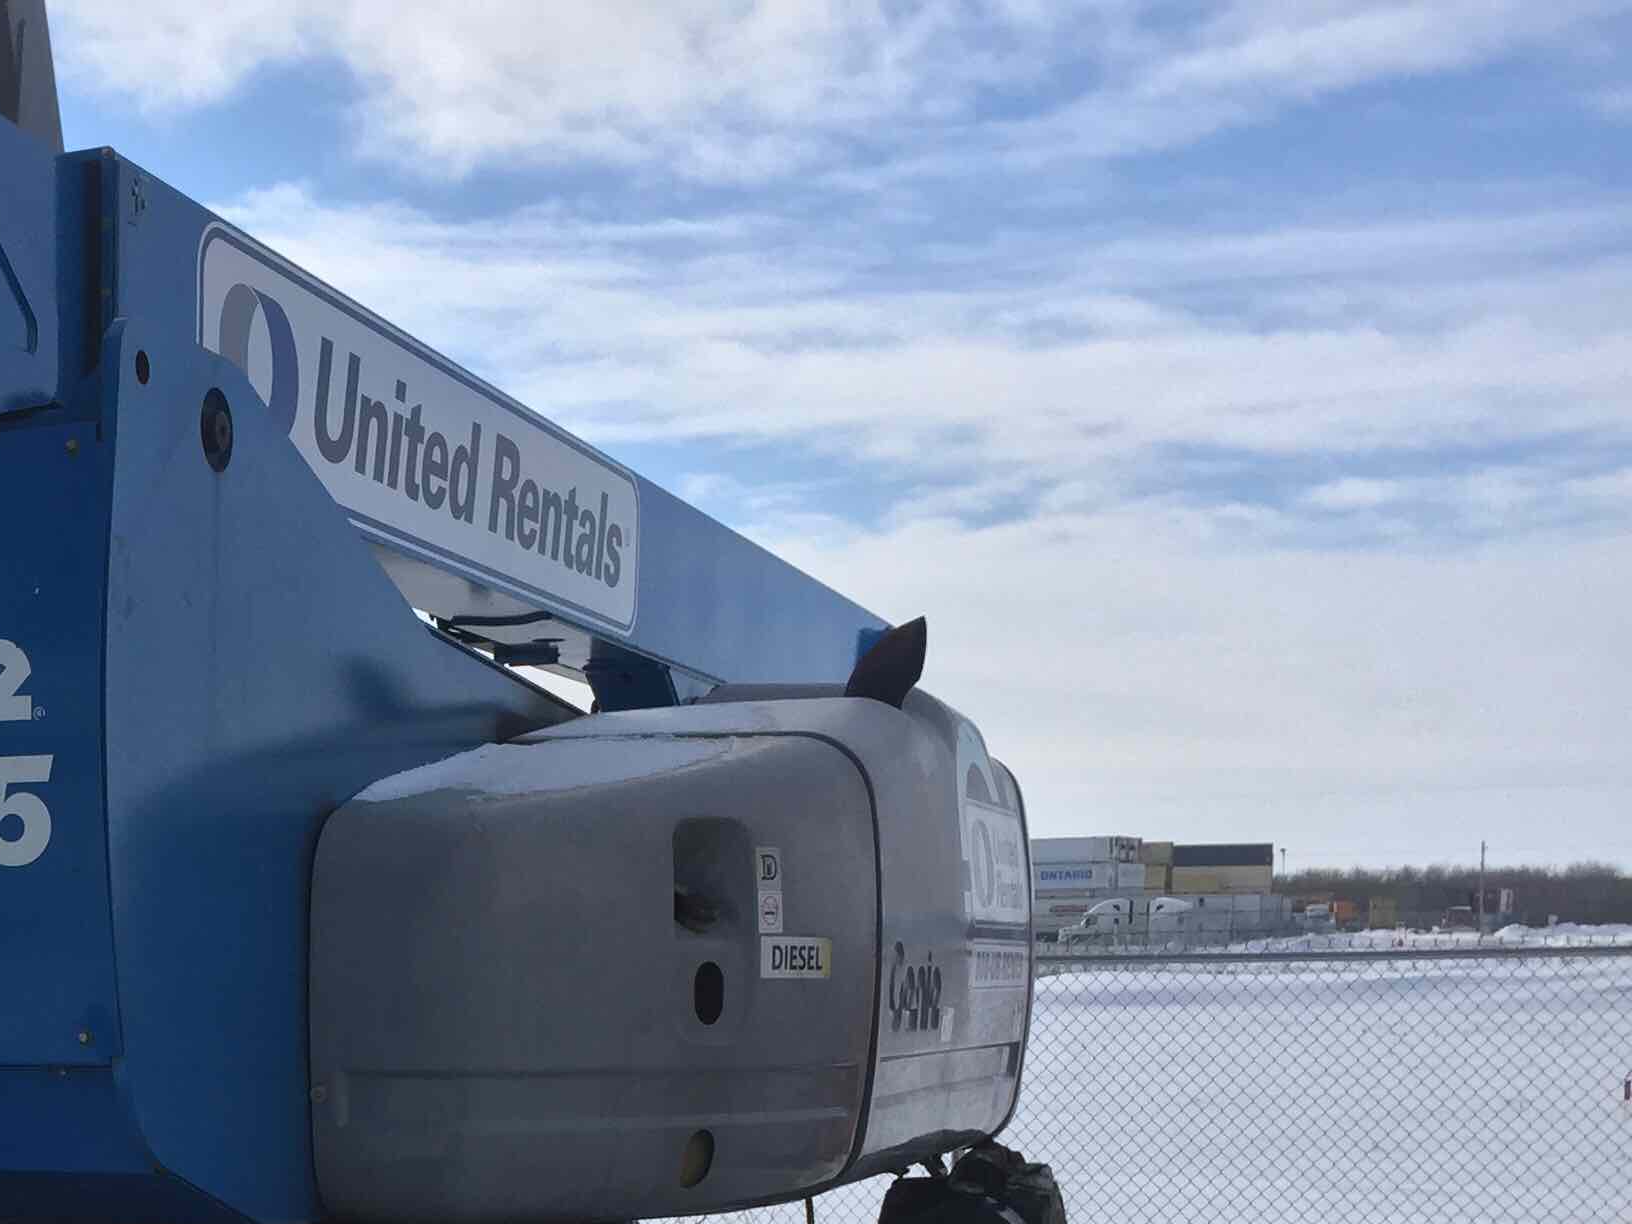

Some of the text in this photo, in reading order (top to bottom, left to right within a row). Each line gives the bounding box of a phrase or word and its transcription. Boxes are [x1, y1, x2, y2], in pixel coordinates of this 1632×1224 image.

[312, 336, 624, 588] United Rentals
[771, 944, 823, 972] DIESEL
